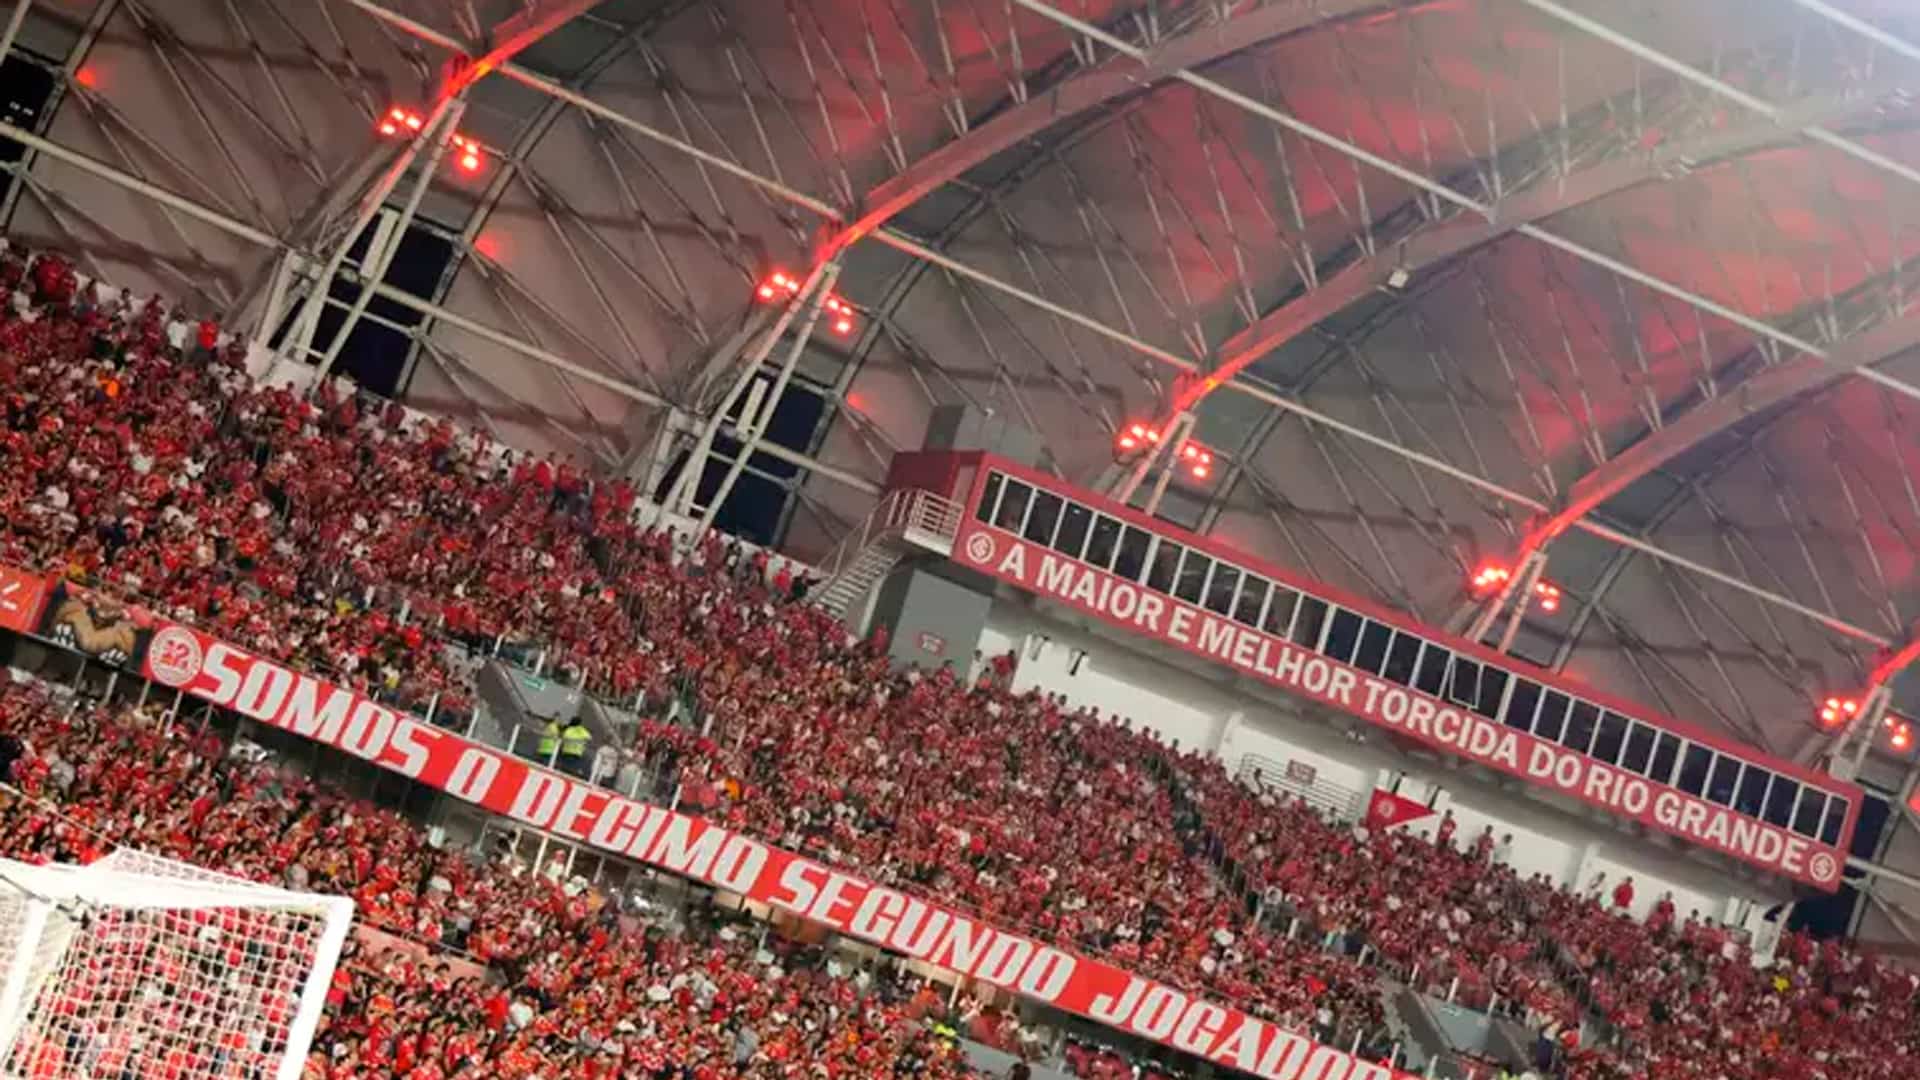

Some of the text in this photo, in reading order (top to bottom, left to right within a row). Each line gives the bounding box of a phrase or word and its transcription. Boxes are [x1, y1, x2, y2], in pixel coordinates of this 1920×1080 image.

[190, 641, 445, 780] SOMOS
[444, 748, 503, 804] O
[507, 768, 769, 893] DECIMO
[766, 856, 1079, 1002] SEGUNDO
[999, 541, 1810, 874] A MAIOR E MELHOR TORCIDA DO RIO GRANDE
